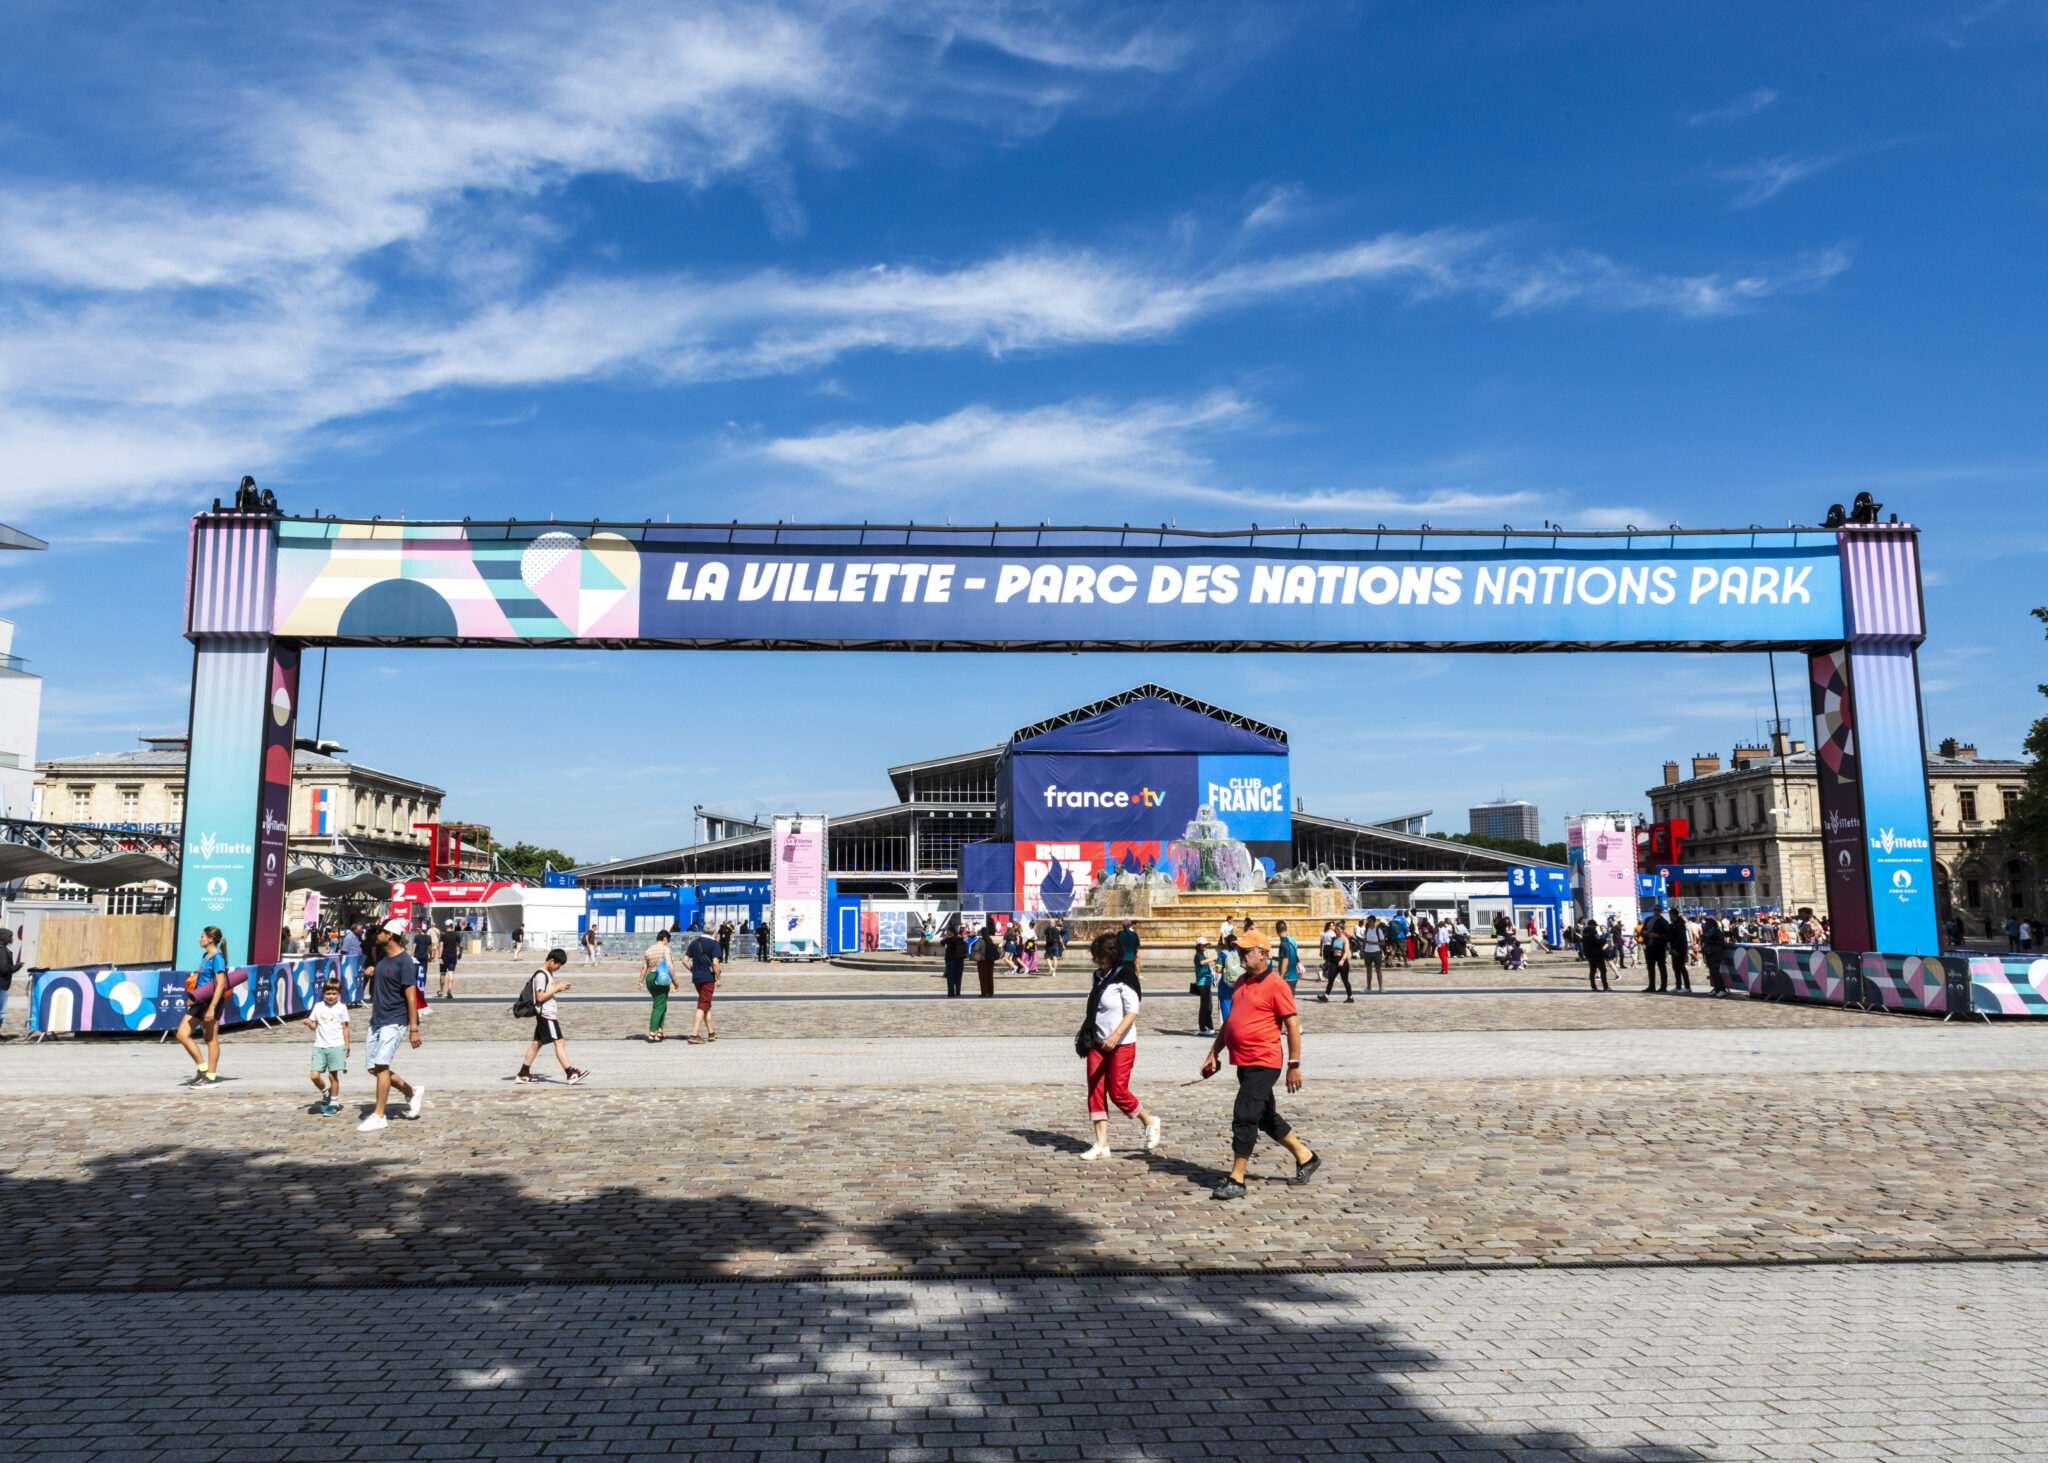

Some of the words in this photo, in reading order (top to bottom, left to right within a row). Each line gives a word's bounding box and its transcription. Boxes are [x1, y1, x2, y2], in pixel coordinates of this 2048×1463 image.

[666, 561, 729, 601] LA
[738, 563, 956, 602] VILLETTE
[964, 578, 986, 589] -
[995, 564, 1138, 604] PARC
[1147, 565, 1241, 604] DES
[1249, 565, 1463, 605] NATIONS
[1474, 565, 1677, 605] NATIONS
[1689, 566, 1813, 604] PARK
[1229, 778, 1262, 789] CLUB
[1208, 782, 1284, 812] FRANCE
[1036, 844, 1080, 860] REN
[1513, 868, 1525, 886] 3
[393, 883, 405, 902] 2
[880, 912, 906, 921] FRA
[880, 921, 906, 936] 20
